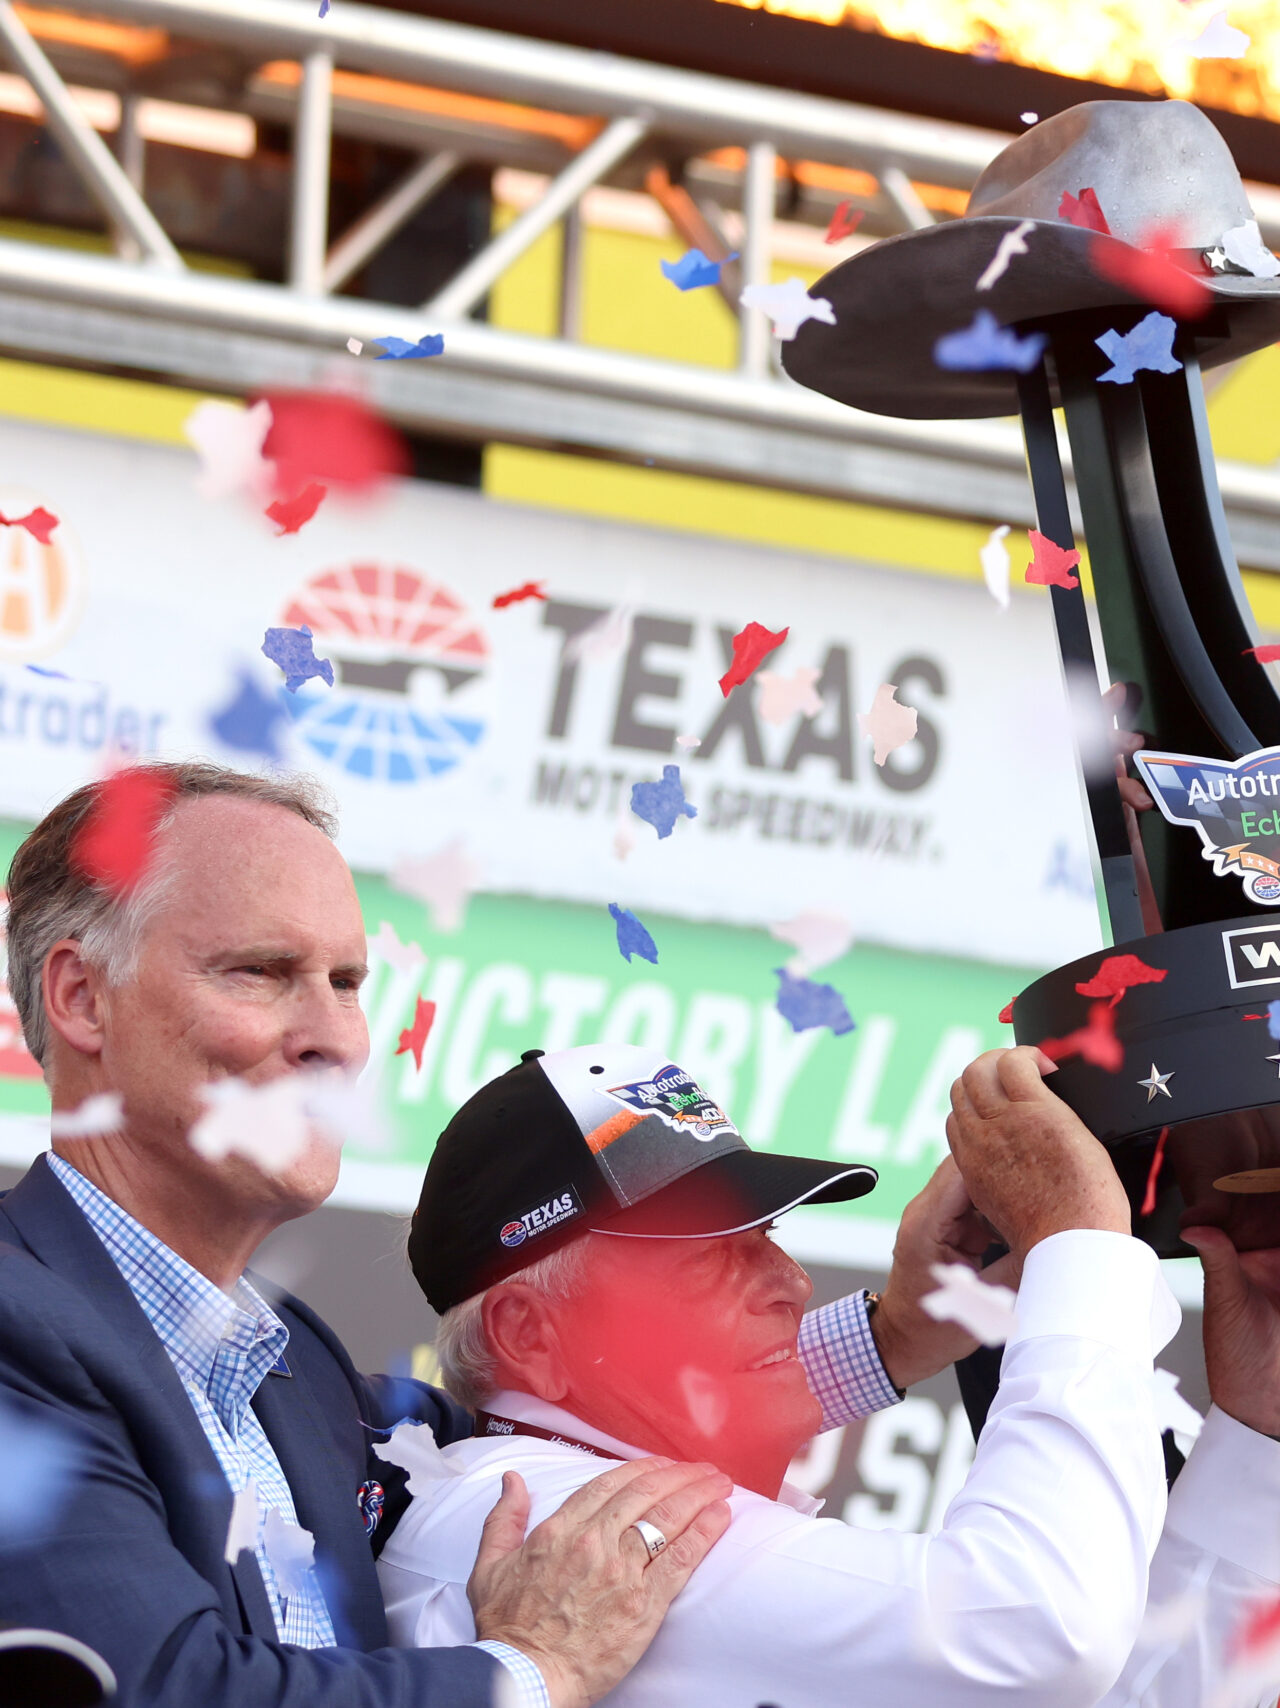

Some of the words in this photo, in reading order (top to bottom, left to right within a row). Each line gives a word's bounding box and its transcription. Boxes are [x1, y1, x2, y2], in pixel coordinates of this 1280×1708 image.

[541, 597, 949, 794] TEXAS
[533, 764, 692, 826] MOT
[520, 1193, 573, 1231] TEXAS
[527, 1222, 547, 1237] MOTOR
